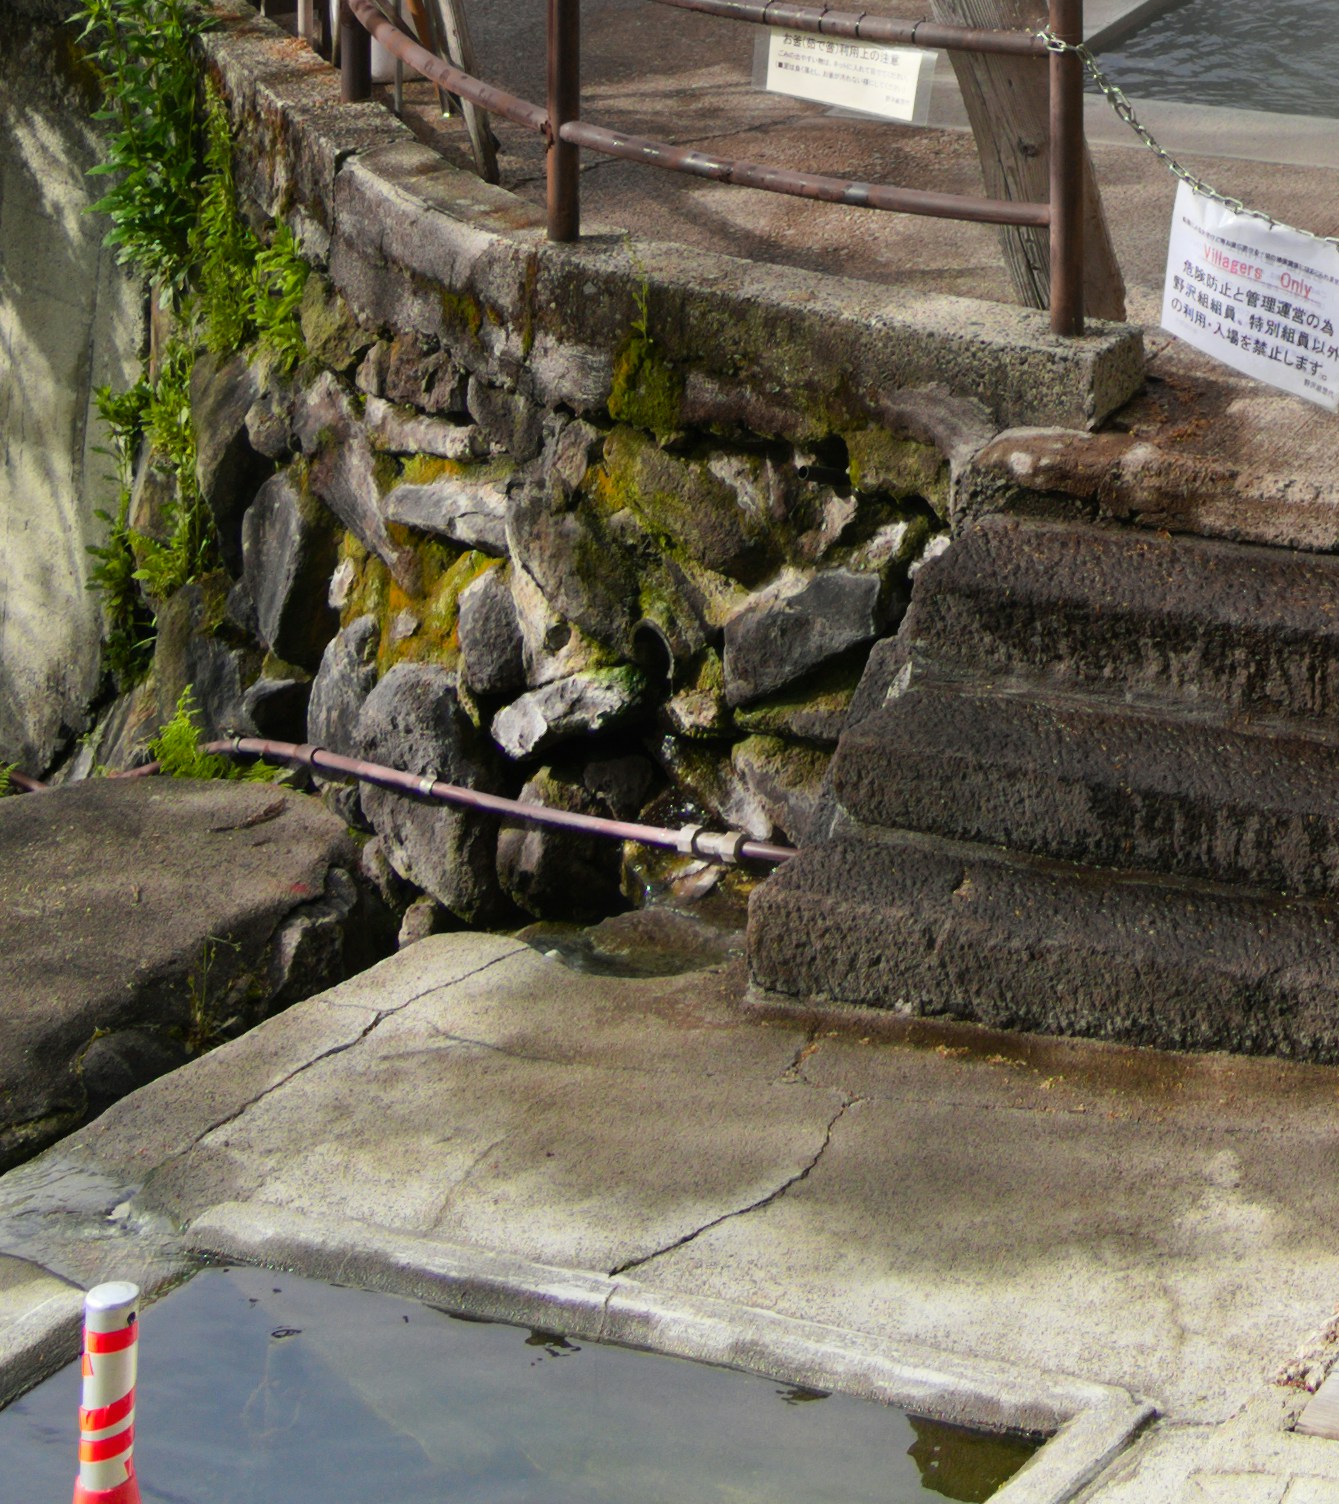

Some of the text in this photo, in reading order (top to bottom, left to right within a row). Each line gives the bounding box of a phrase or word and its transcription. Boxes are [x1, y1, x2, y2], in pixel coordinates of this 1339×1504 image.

[1182, 259, 1335, 337] 危険防止と管理運営の為
[1203, 244, 1263, 281] Villagers
[1279, 272, 1313, 300] Only
[1170, 297, 1328, 381] の利用・入場を禁止します。
